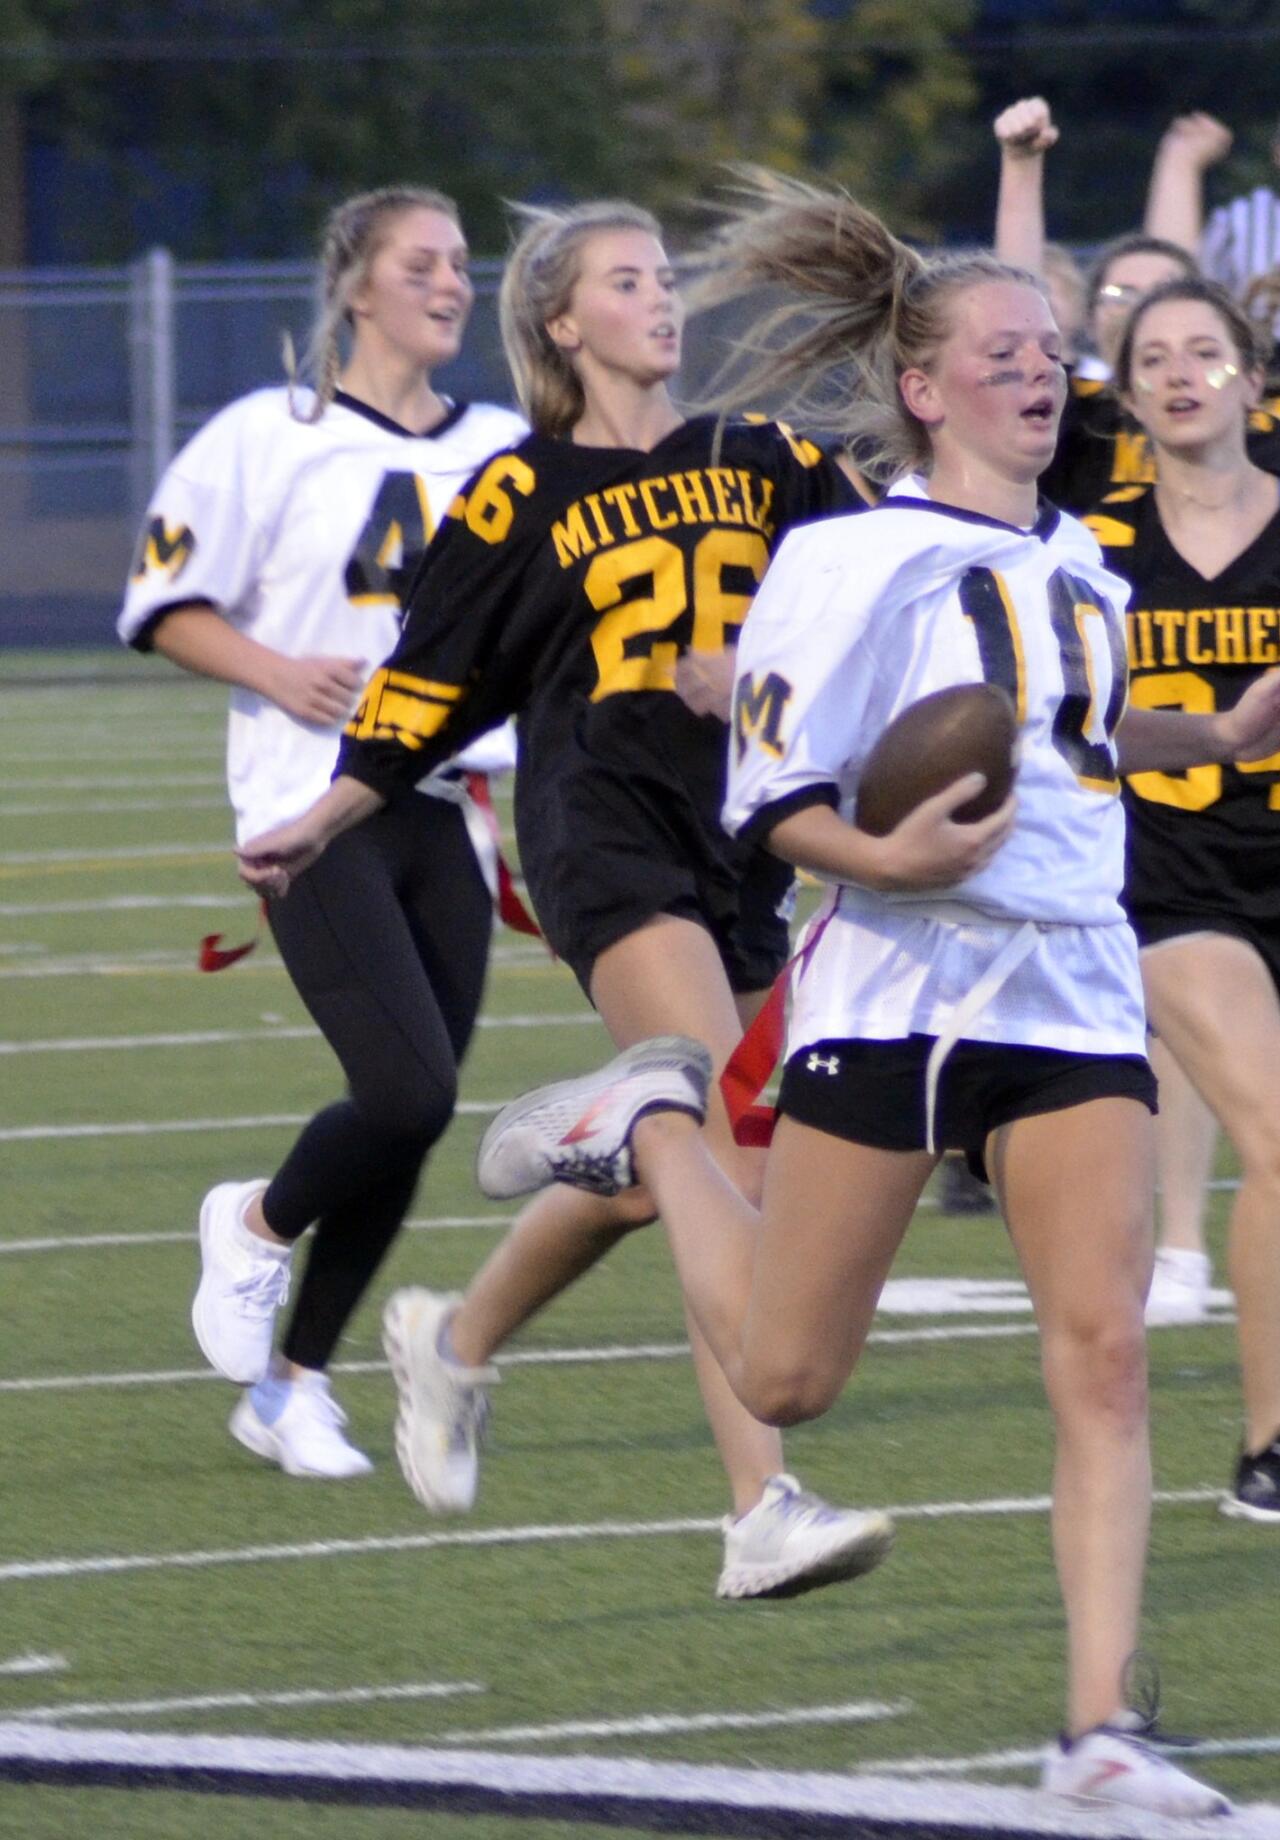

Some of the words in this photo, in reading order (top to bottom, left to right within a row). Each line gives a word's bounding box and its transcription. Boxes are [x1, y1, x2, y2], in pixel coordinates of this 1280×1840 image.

[446, 454, 536, 545] 6
[735, 671, 793, 768] M
[957, 564, 1129, 796] 10
